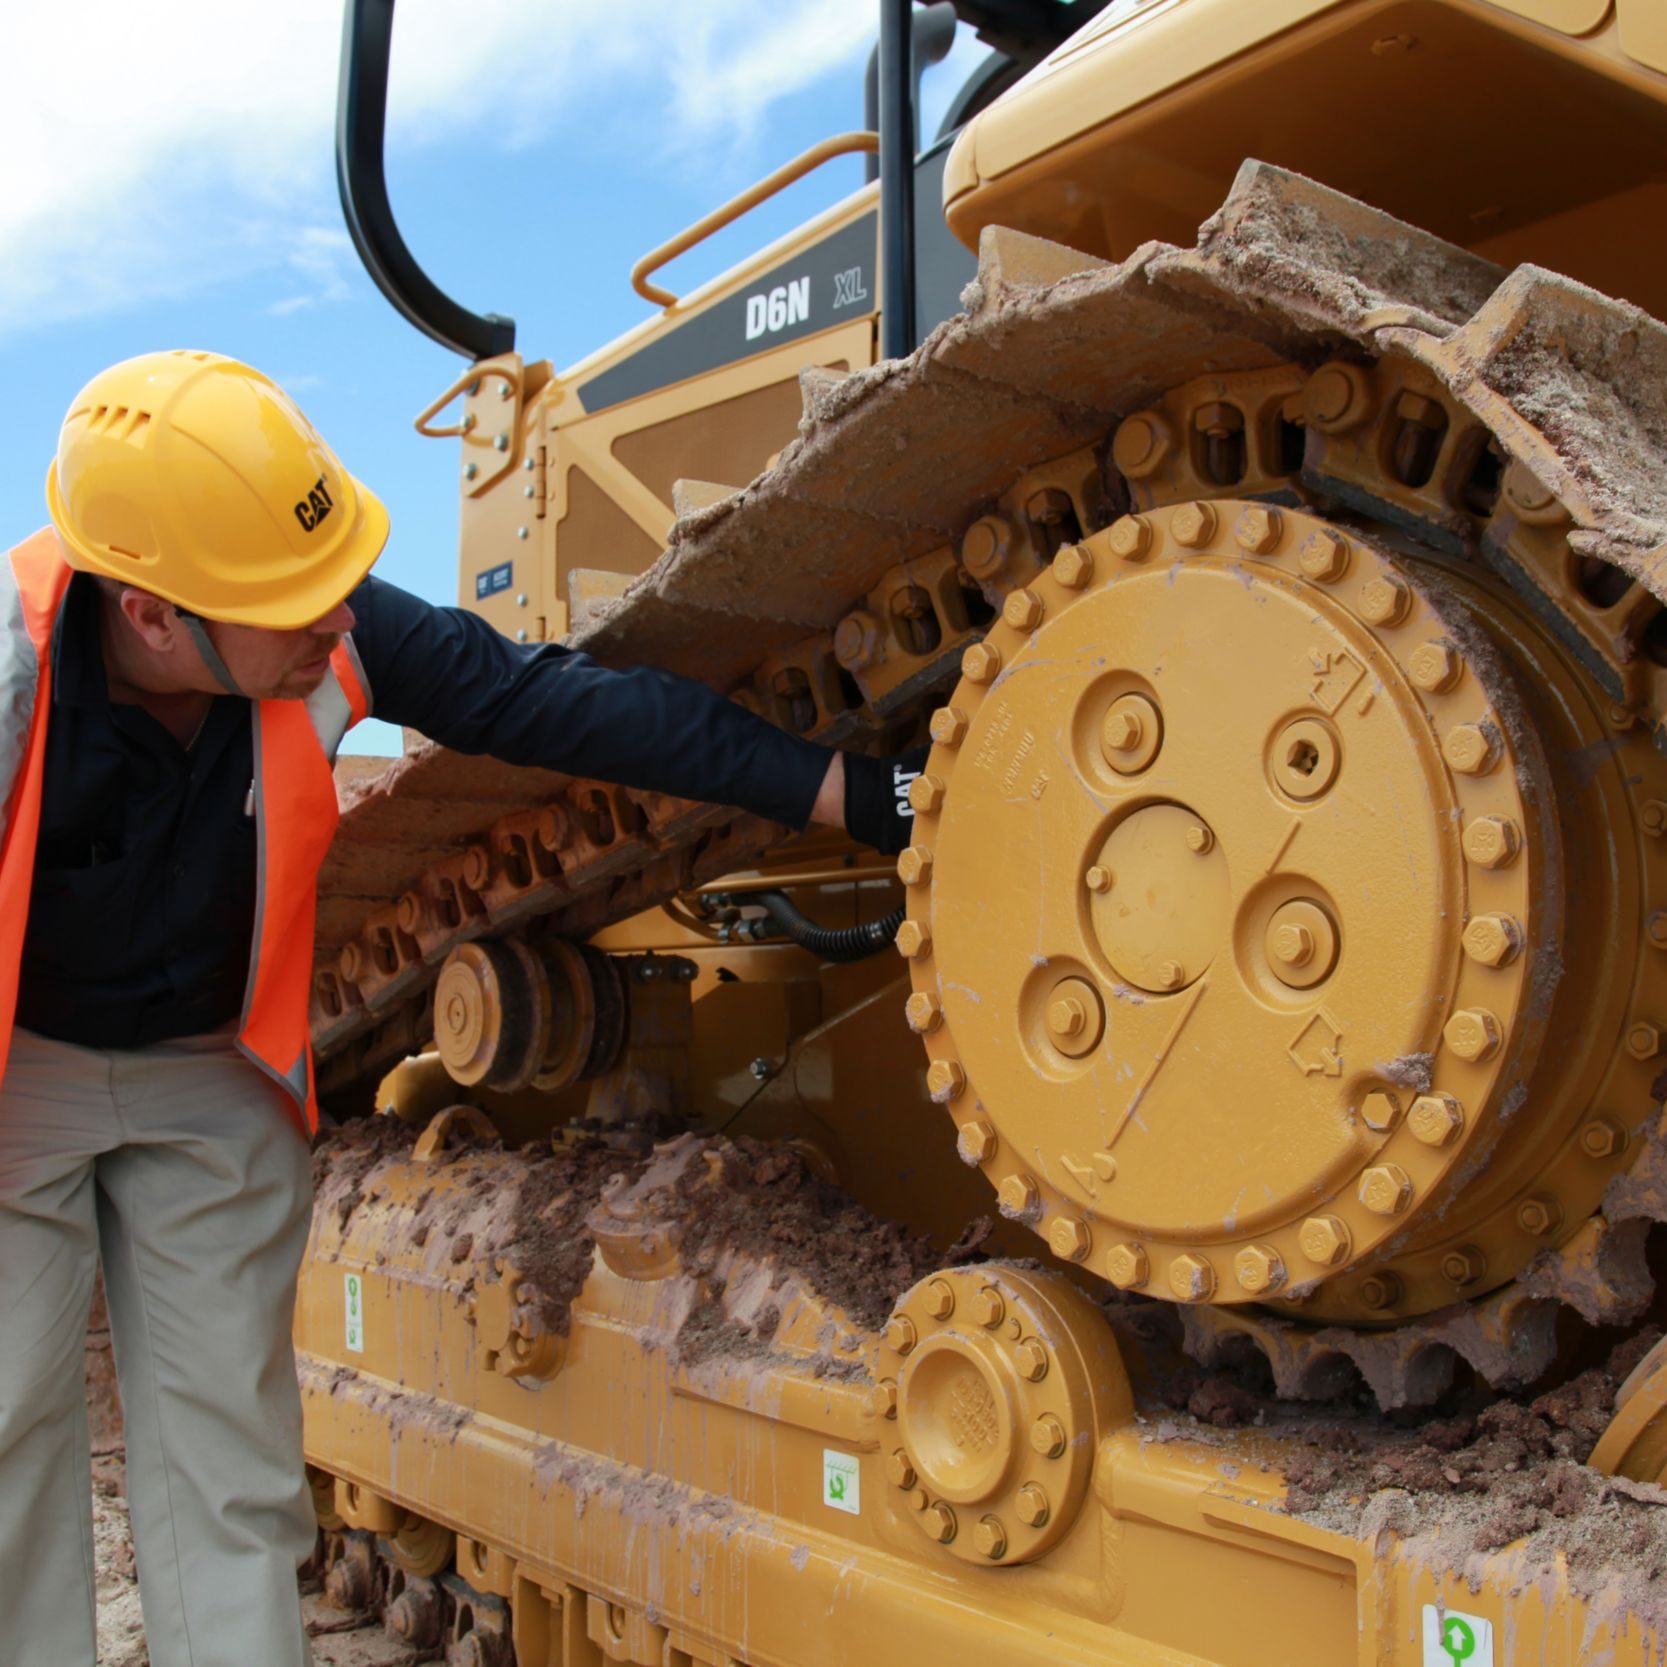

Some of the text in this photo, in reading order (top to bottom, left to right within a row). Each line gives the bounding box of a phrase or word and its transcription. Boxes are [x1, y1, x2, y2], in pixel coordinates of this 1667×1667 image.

[745, 266, 868, 341] D6N XL
[294, 477, 334, 533] CAT
